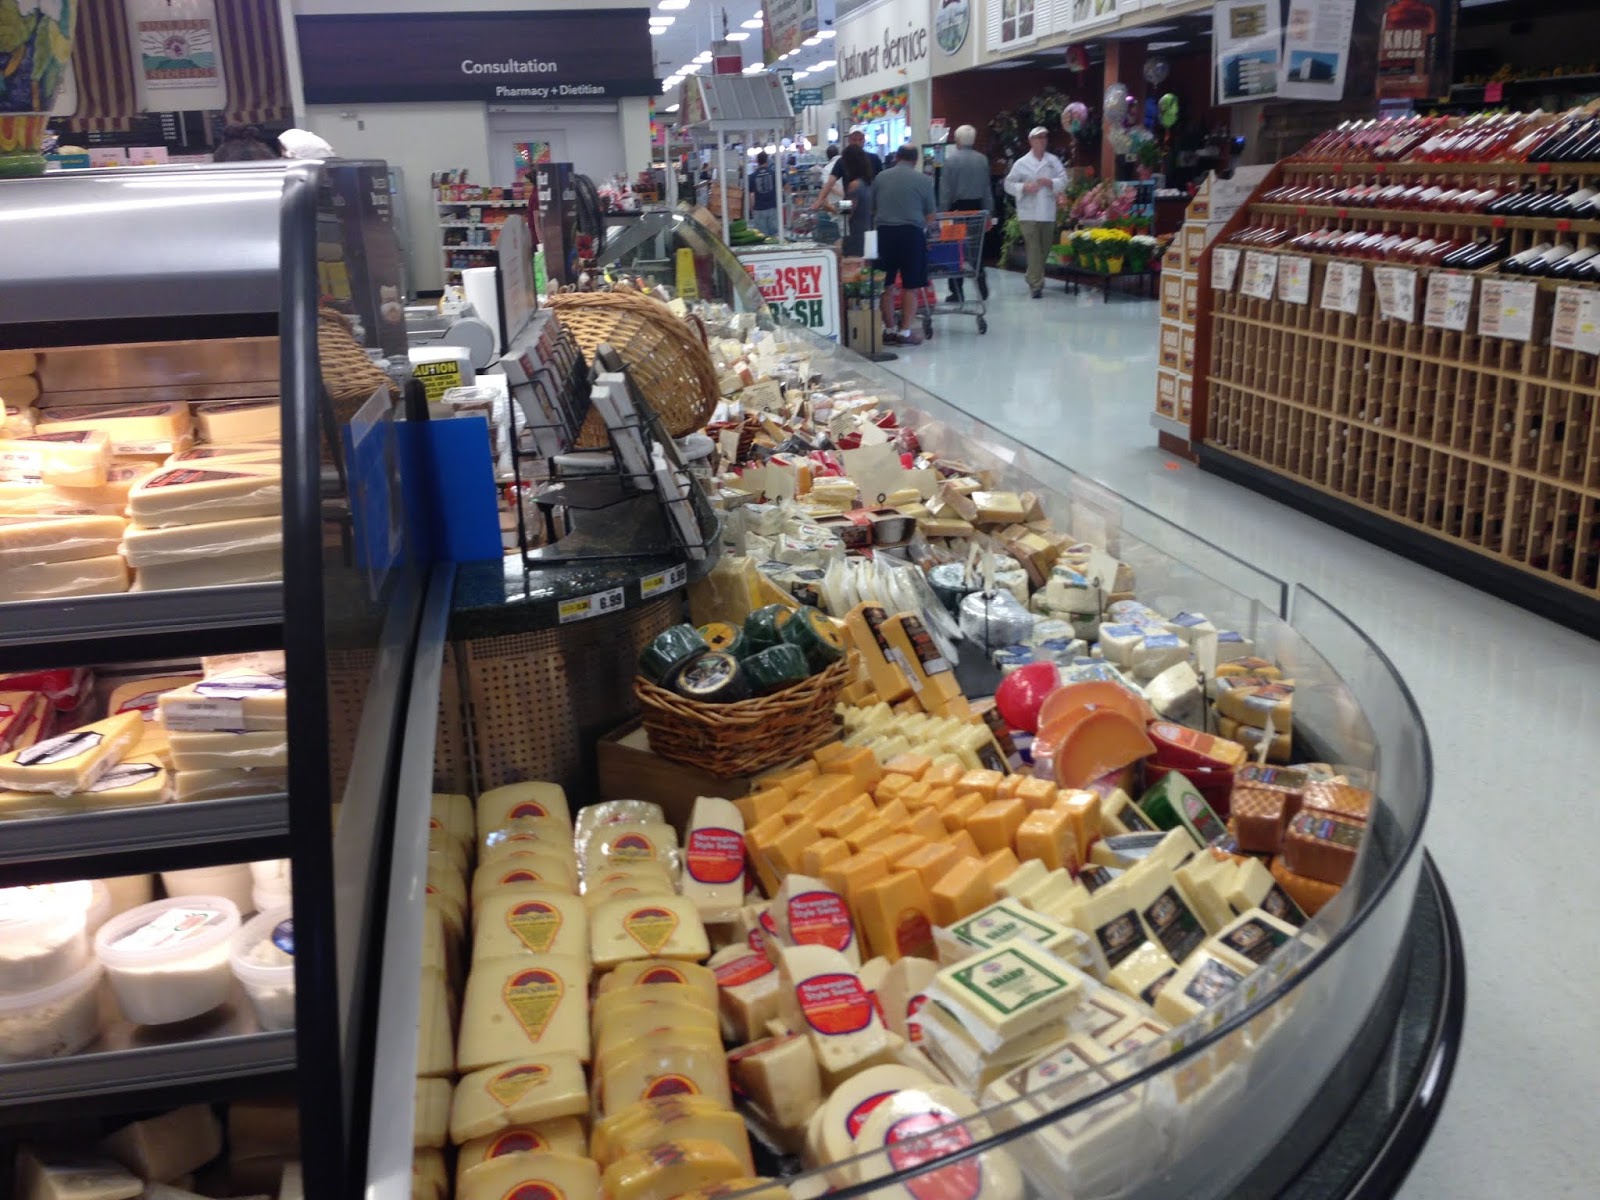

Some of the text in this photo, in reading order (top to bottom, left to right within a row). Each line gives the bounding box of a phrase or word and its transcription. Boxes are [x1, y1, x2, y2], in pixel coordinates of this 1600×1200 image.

[1384, 29, 1422, 49] KNOB
[838, 44, 879, 82] Customer
[882, 20, 927, 69] Service
[461, 59, 557, 74] Consultation
[496, 86, 549, 97] Pharmacy
[560, 84, 605, 95] Dietitian
[414, 362, 456, 376] AUTION
[600, 593, 622, 610] 6.99
[694, 833, 739, 843] Norwegian
[791, 898, 839, 909] Norwegian
[802, 979, 855, 993] Norwegian
